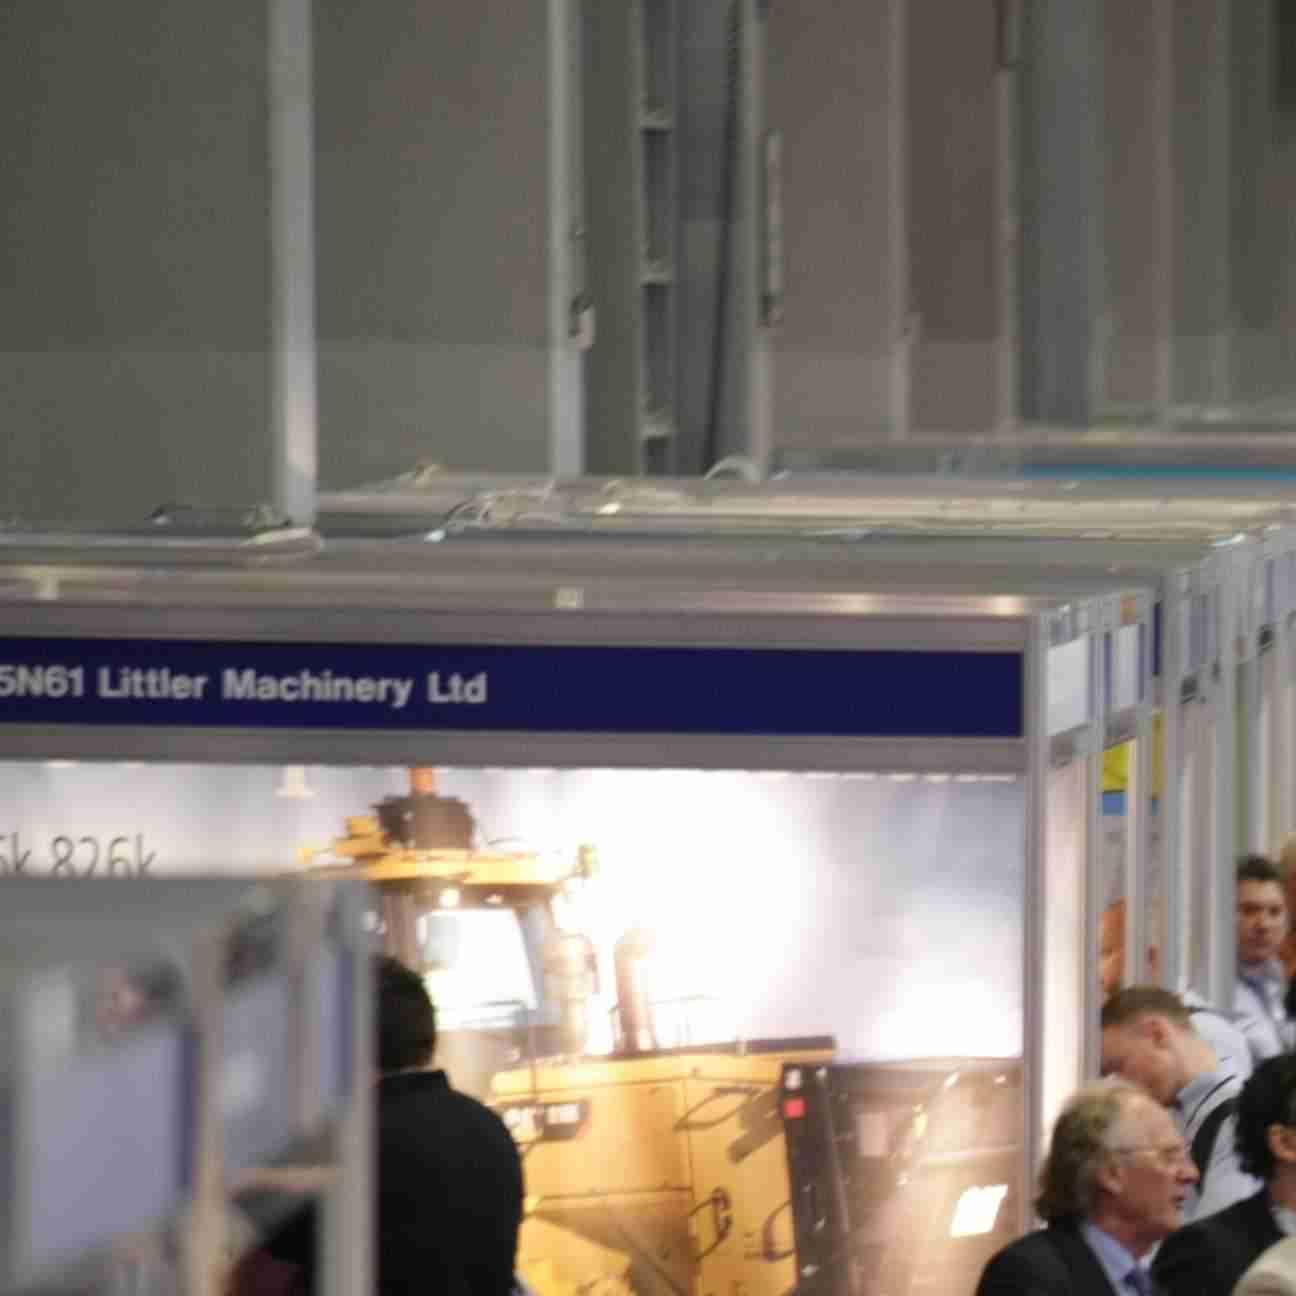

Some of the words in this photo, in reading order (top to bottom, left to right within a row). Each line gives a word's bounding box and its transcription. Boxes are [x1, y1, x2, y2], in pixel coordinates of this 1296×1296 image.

[0, 664, 85, 699] 5N61
[99, 665, 208, 699] Littler
[223, 669, 414, 707] Machinery
[429, 672, 488, 704] Ltd
